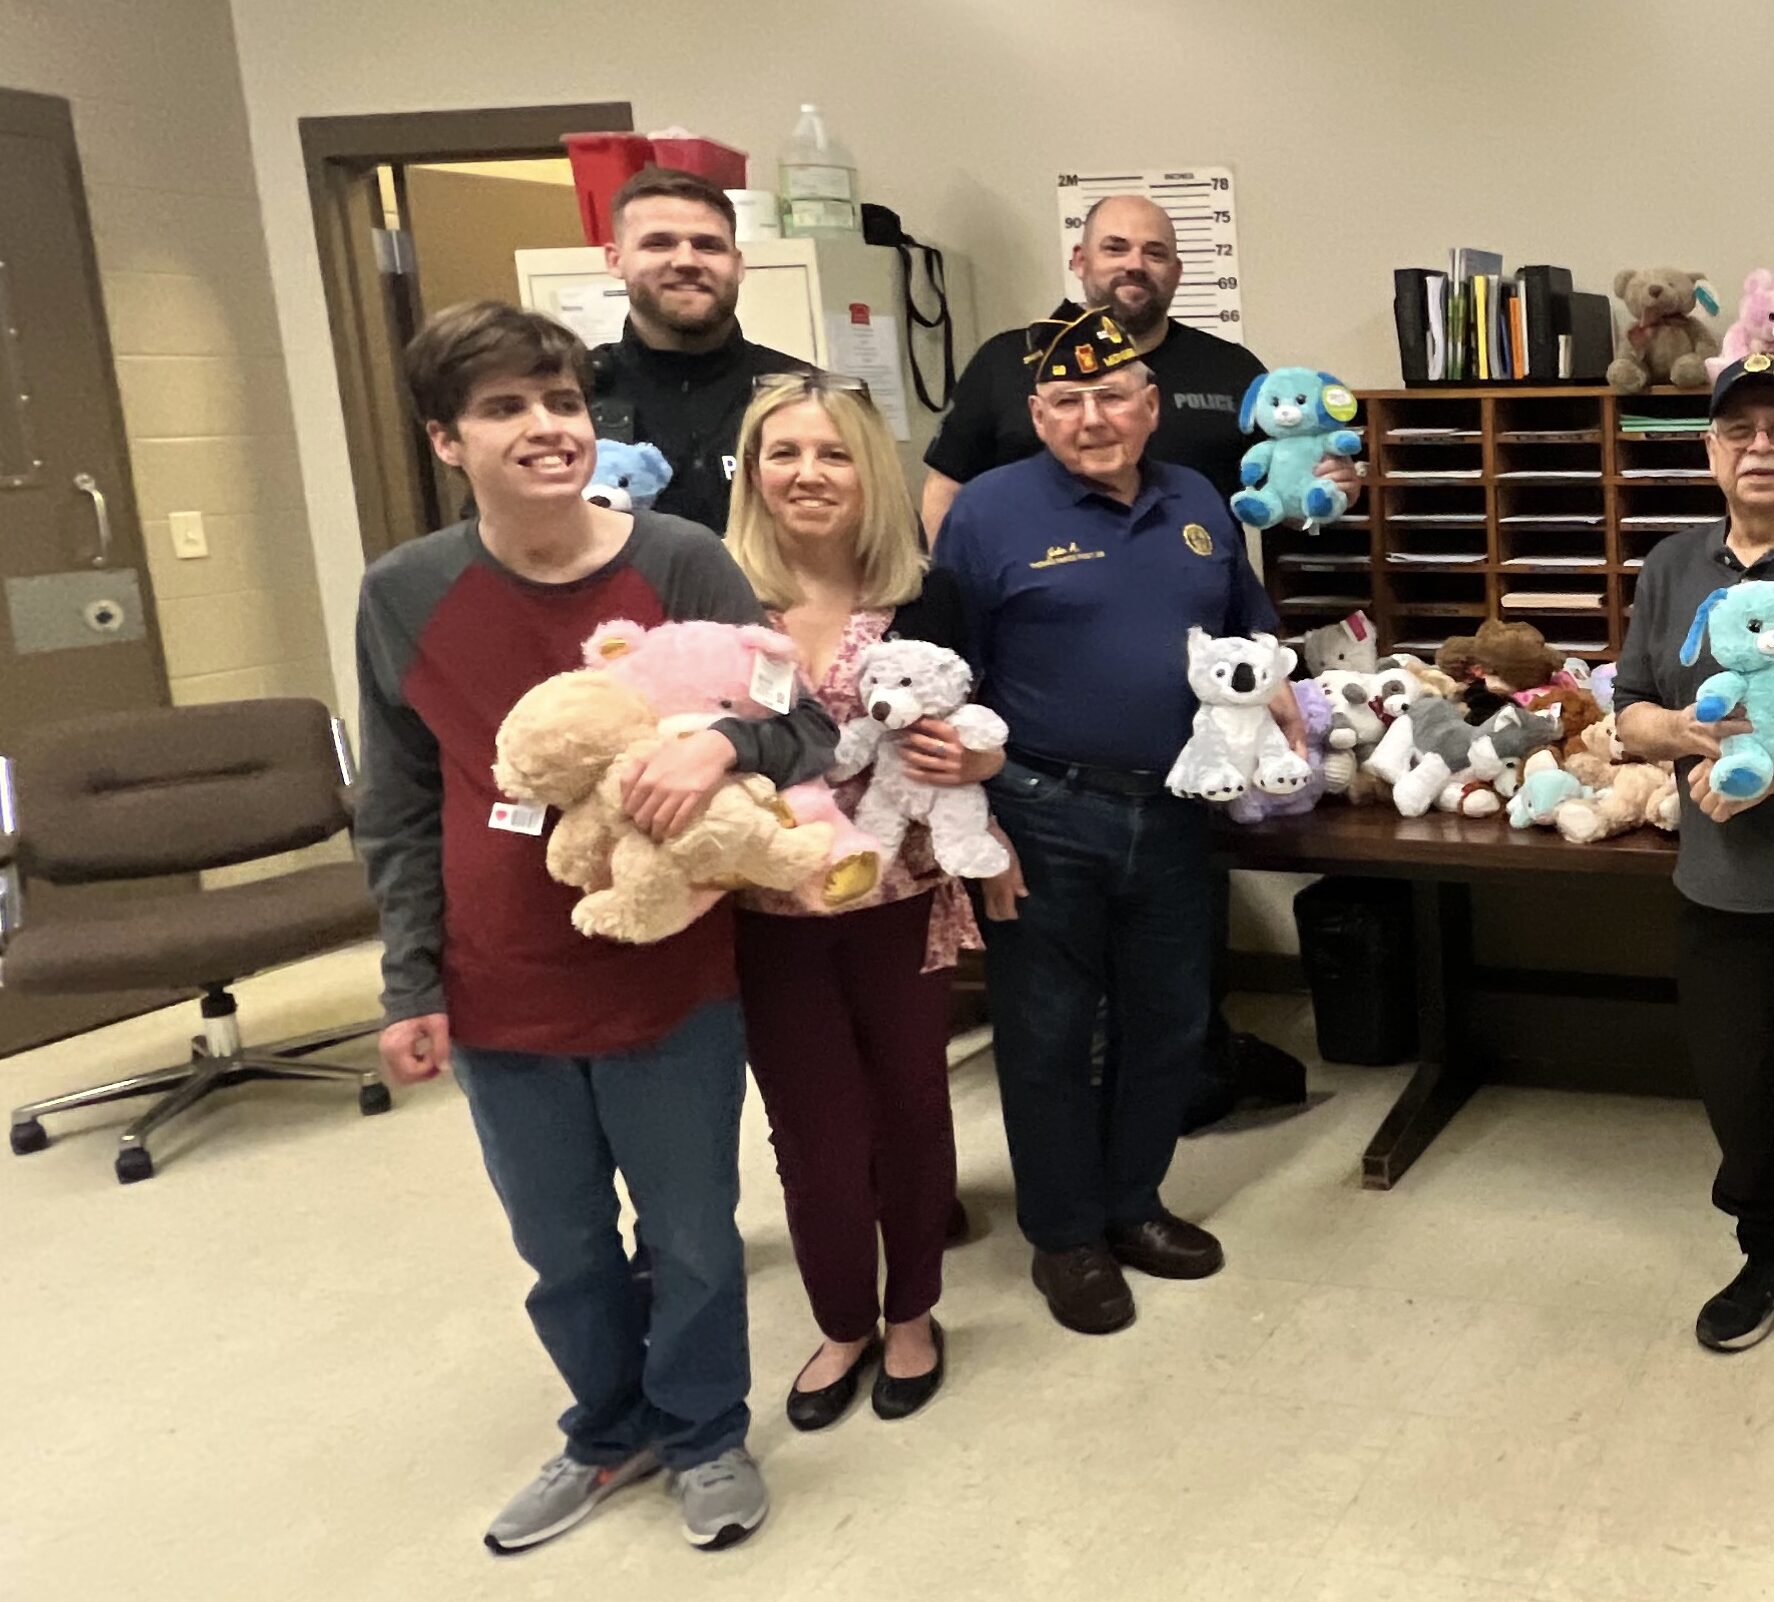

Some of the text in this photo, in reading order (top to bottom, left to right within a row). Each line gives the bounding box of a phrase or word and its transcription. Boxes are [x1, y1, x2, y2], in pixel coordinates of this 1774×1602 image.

[1058, 174, 1078, 186] 2M
[1211, 177, 1229, 191] 78
[1065, 217, 1082, 228] 90
[1214, 211, 1231, 223] 75
[1216, 244, 1233, 256] 72
[1219, 277, 1238, 289] 69
[1221, 310, 1240, 322] 66
[1173, 393, 1237, 413] POLICE
